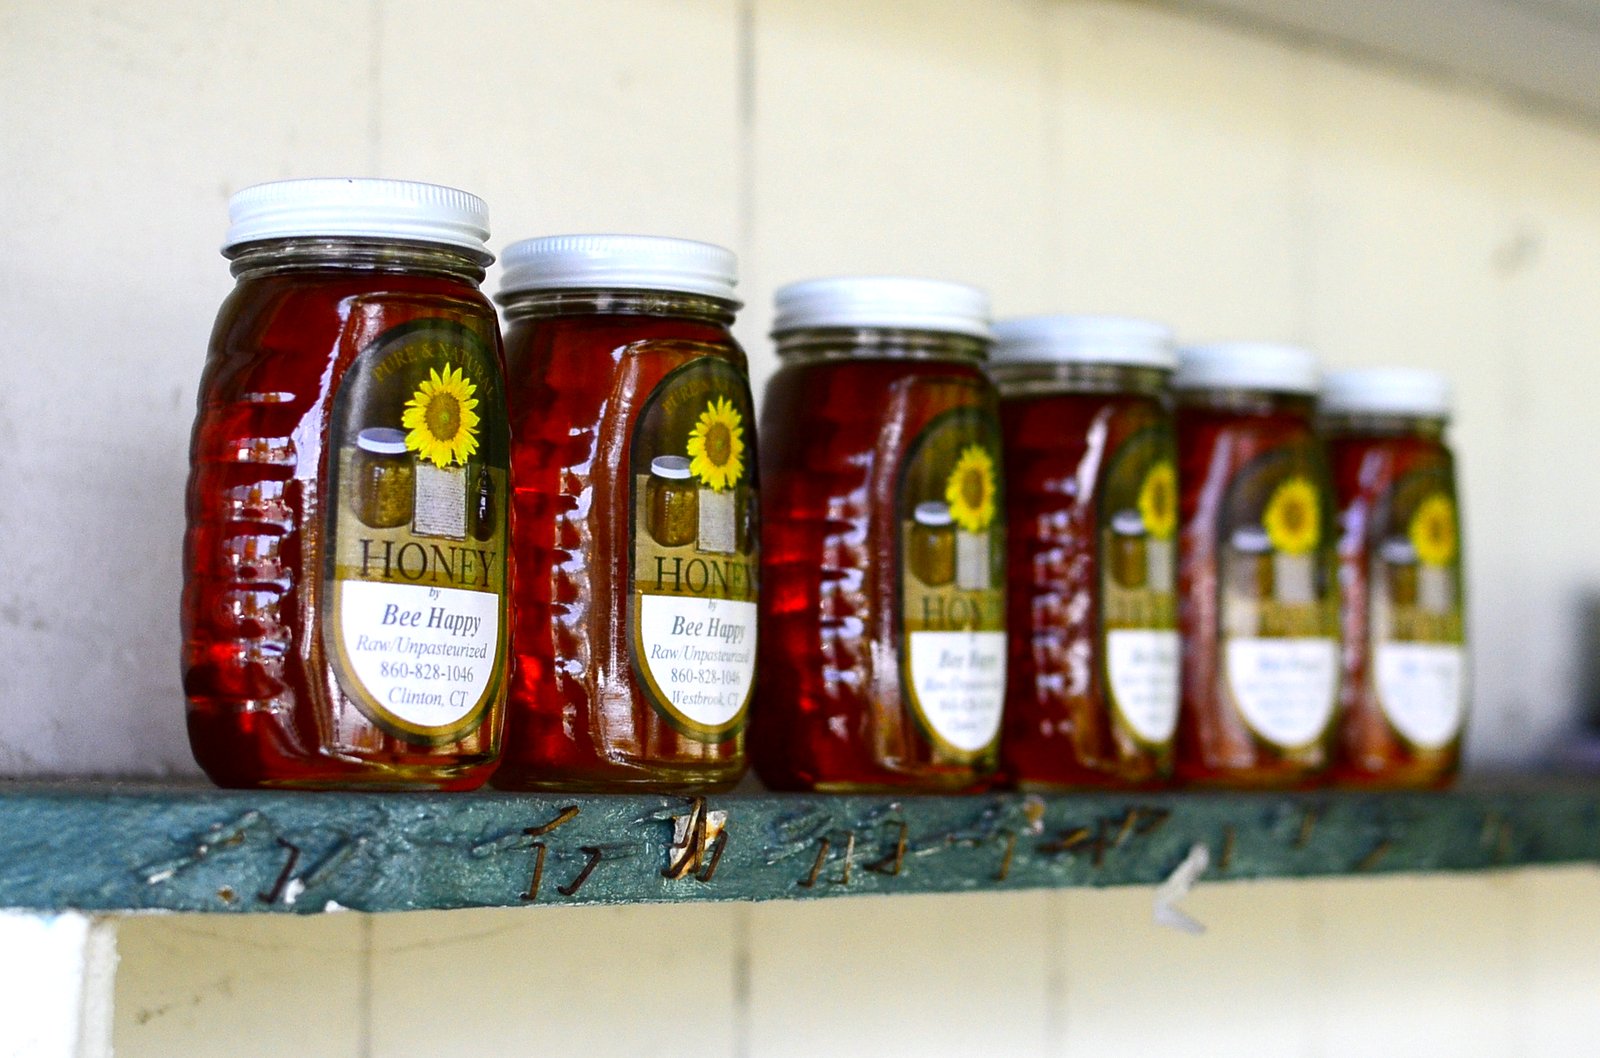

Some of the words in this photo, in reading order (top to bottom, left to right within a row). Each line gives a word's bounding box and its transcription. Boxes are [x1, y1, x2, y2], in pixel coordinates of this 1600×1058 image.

[359, 539, 496, 587] HONEY
[429, 587, 442, 600] by
[382, 603, 422, 627] Bee
[427, 606, 481, 637] Happy
[671, 615, 703, 636] Bee
[707, 617, 746, 644] Happy
[356, 634, 488, 659] Raw/Unpasteurized
[381, 661, 474, 682] 860-828-1046
[388, 686, 444, 707] Clinton,
[450, 690, 468, 708] CT
